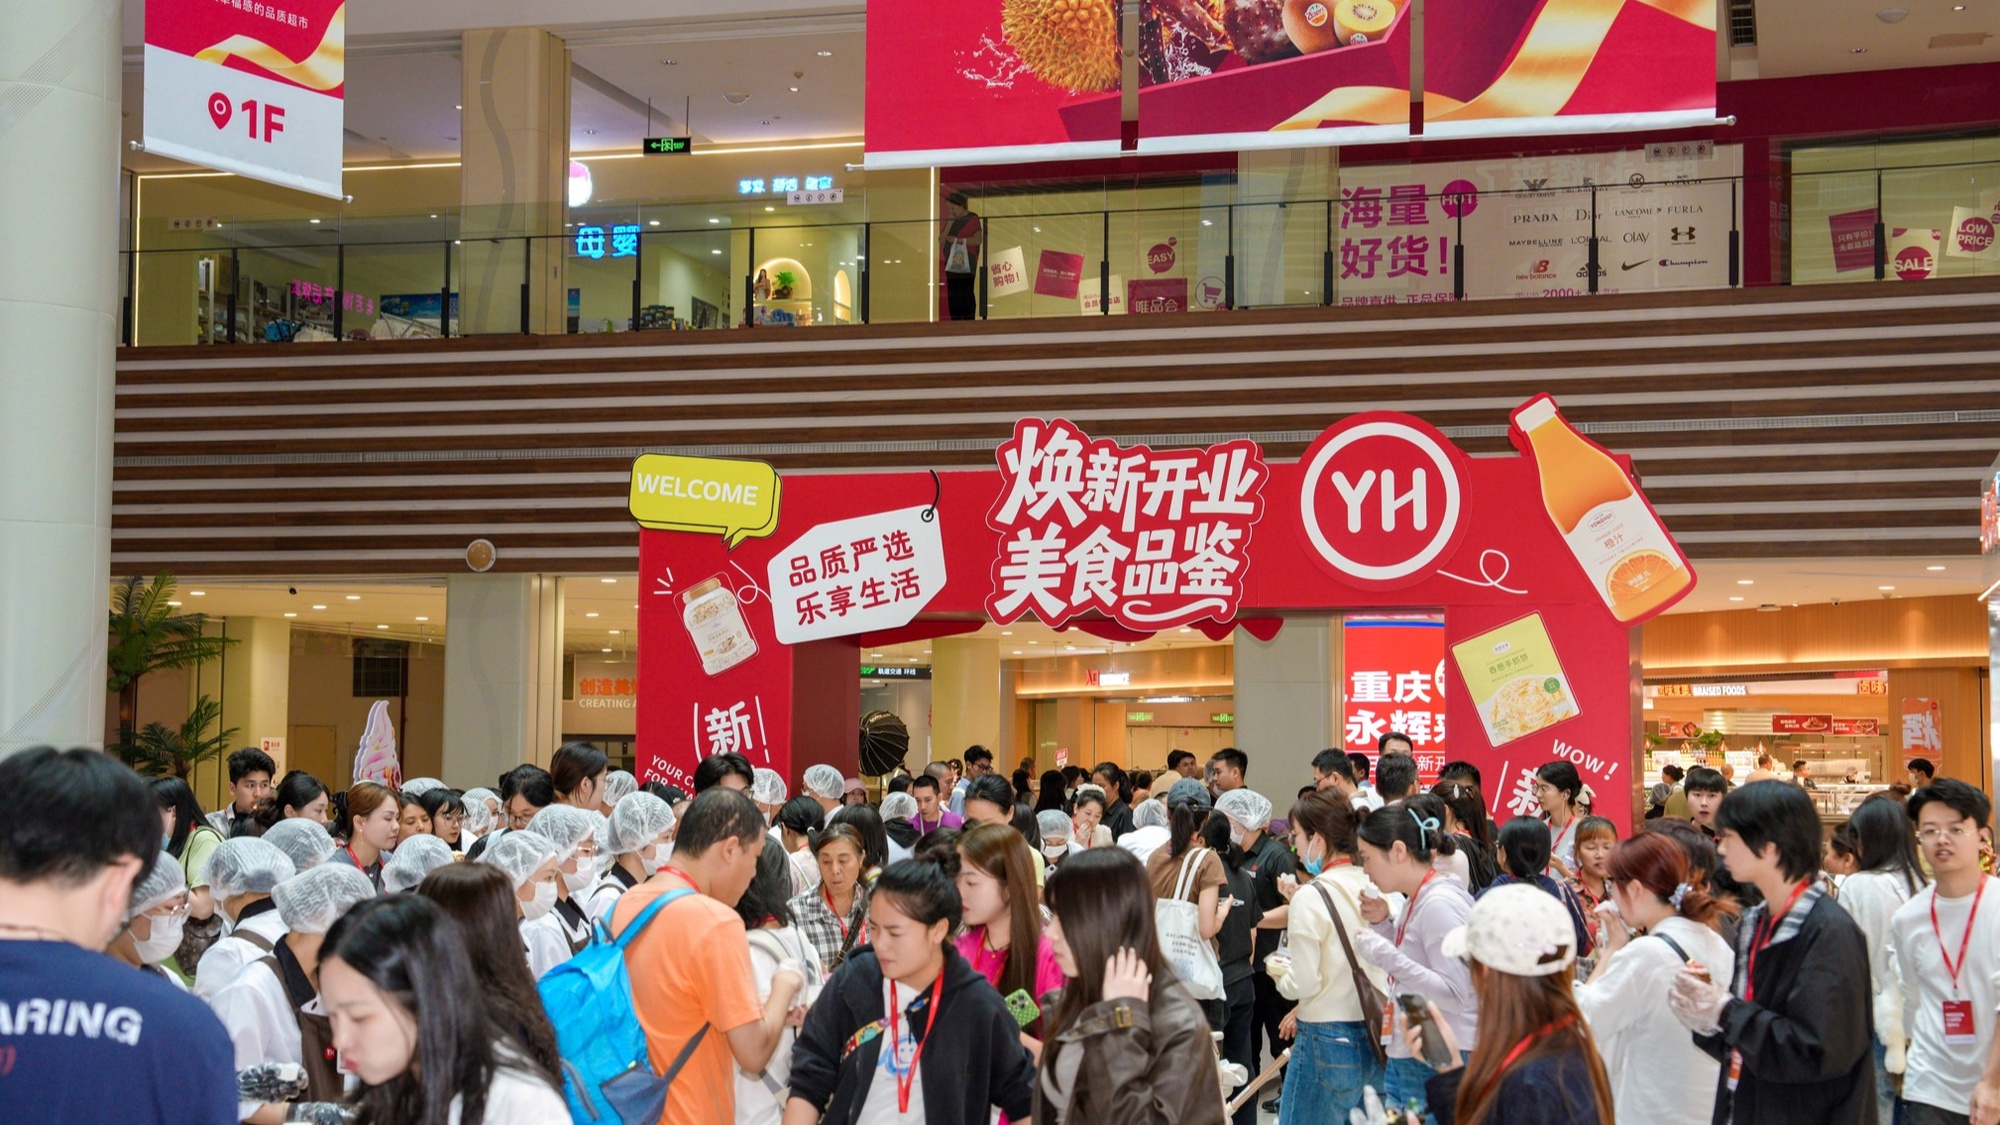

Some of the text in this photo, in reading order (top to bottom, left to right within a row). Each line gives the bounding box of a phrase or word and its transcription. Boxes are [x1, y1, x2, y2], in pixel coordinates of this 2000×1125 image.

[242, 99, 285, 143] 1F
[1340, 184, 1430, 230] 海量
[1667, 205, 1704, 214] FURLA
[1513, 213, 1559, 223] PRADA
[1575, 209, 1602, 221] Dir
[1959, 223, 1988, 234] LOW
[1509, 238, 1563, 246] MAYBELLINE
[1957, 234, 1993, 247] PRICE
[1148, 252, 1174, 264] EASY
[1894, 258, 1932, 272] SALE
[995, 426, 1260, 532] 焕新开业
[637, 472, 759, 506] WELCOME
[1331, 467, 1427, 534] YH
[789, 530, 915, 588] 品质严选
[994, 521, 1242, 618] 美食品鉴
[796, 567, 921, 626] 乐享生活
[1723, 685, 1747, 695] FOODS
[579, 699, 630, 708] CREATING
[651, 755, 683, 781] YOUR
